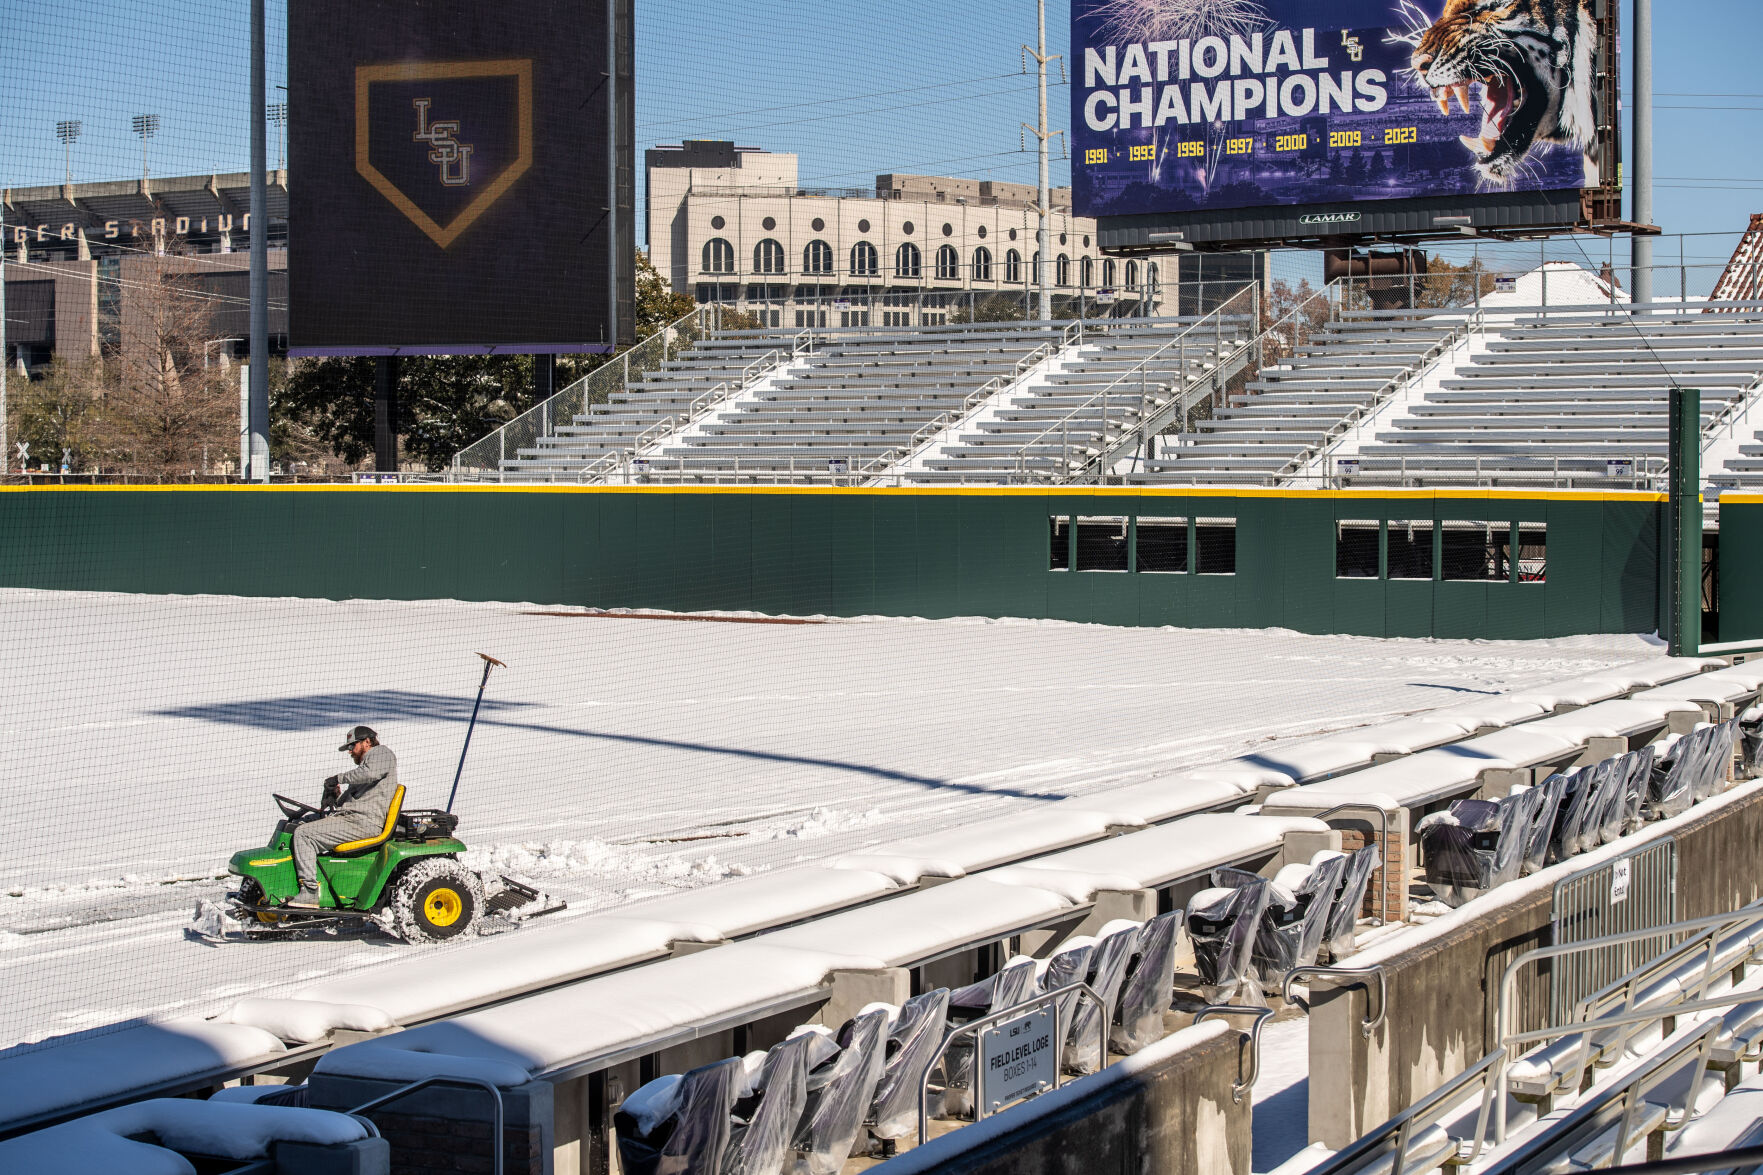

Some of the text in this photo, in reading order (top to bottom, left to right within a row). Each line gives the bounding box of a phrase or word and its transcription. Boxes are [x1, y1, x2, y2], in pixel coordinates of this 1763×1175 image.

[1084, 27, 1329, 88] NATIONAL
[1341, 29, 1364, 62] LSU
[1084, 69, 1388, 132] CHAMPIONS
[413, 98, 473, 186] LSU
[1085, 127, 1417, 165] 1991 1993 1996 1997 2000 2009 2023
[1304, 212, 1355, 223] LAMAR
[1009, 1025, 1021, 1038] LSU
[990, 1034, 1049, 1071] FIELD LEVEL LOGE
[1003, 1056, 1037, 1082] BOXES 1-14
